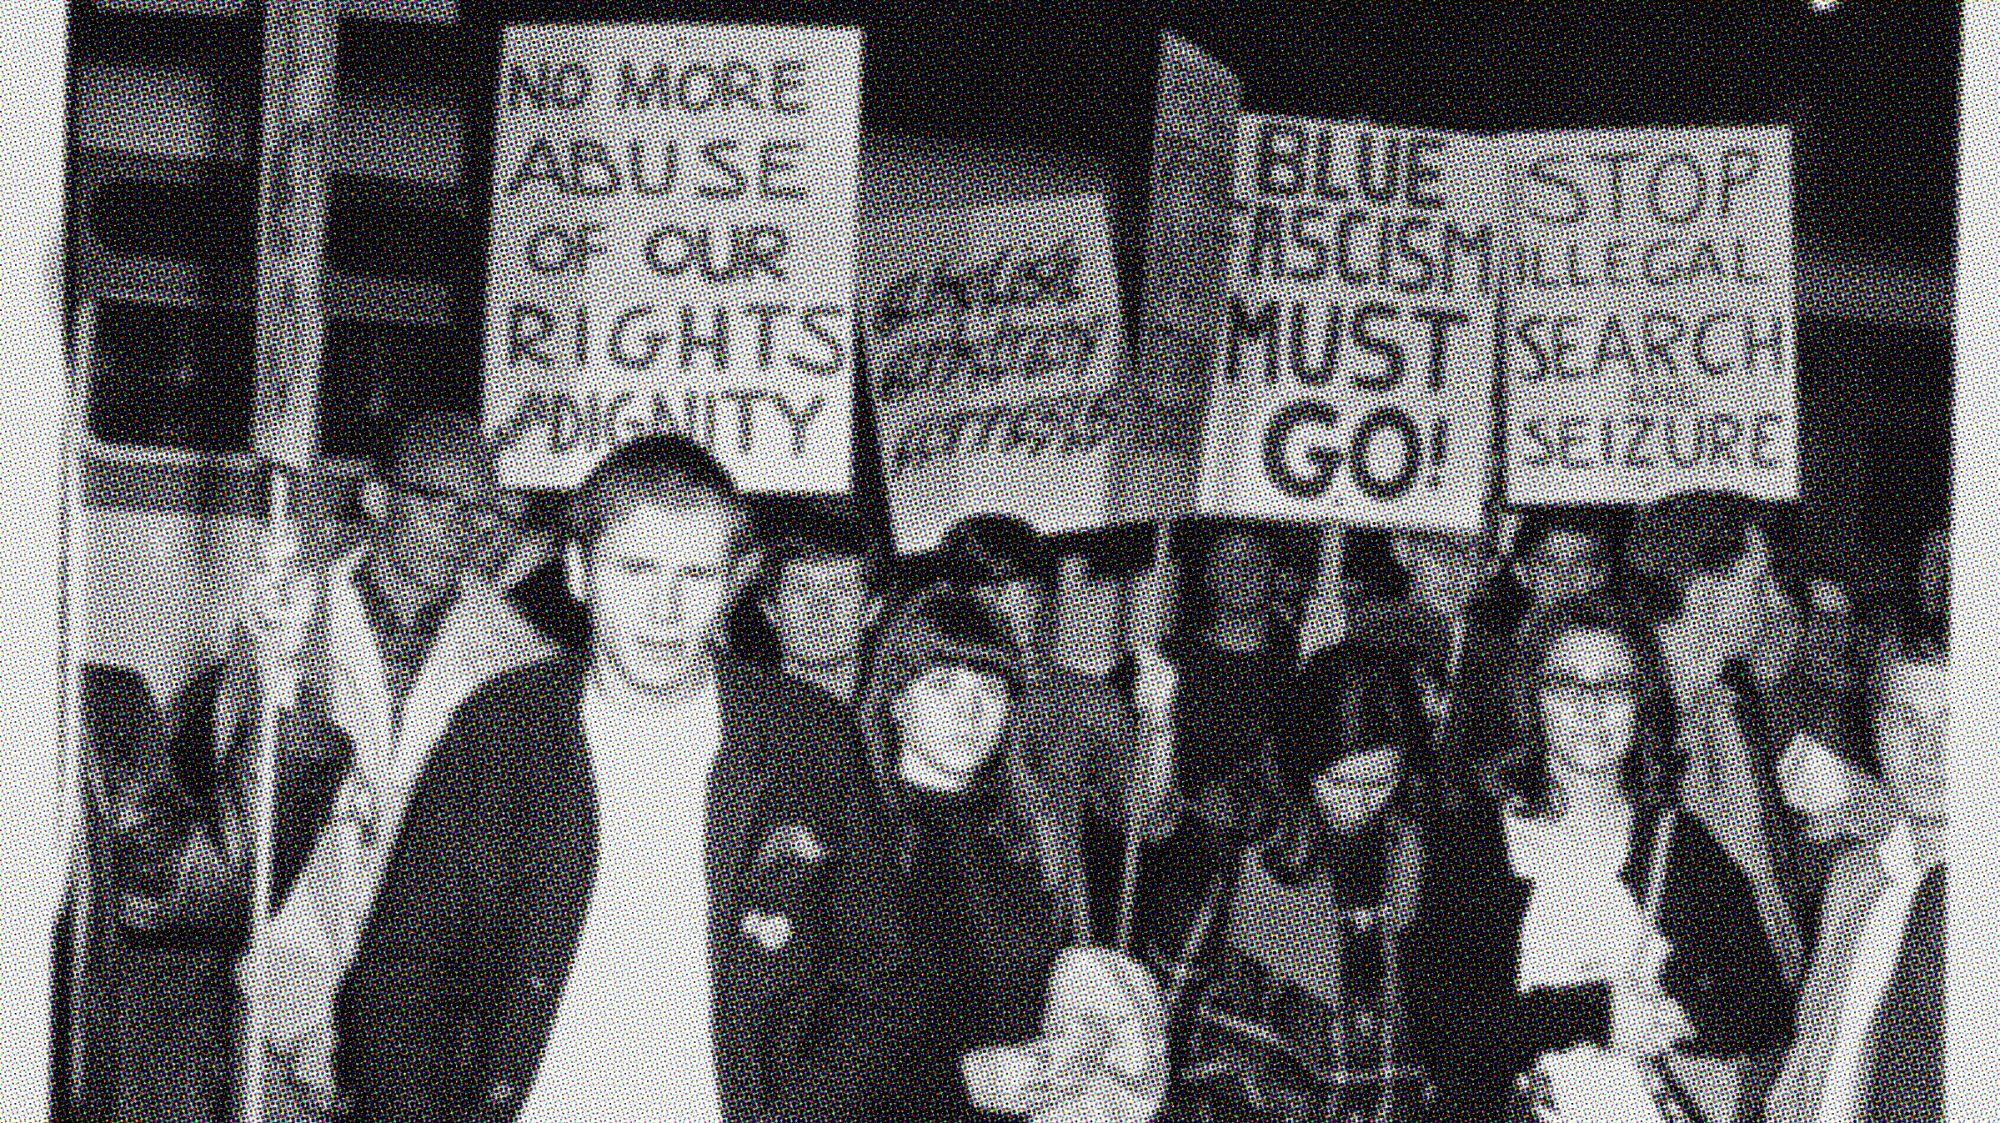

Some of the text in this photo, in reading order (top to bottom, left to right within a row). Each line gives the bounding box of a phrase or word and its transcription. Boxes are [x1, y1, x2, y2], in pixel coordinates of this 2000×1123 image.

[507, 59, 809, 115] NO MORE
[505, 136, 808, 200] ABUSE
[1257, 121, 1449, 210] BLUE
[1525, 147, 1762, 226] STOP
[525, 222, 789, 282] OF OUR
[1514, 236, 1766, 290] ILLEGAL
[507, 303, 846, 376] RIGHTS
[1225, 294, 1471, 394] MUST
[1514, 310, 1784, 382] SEARCH
[550, 388, 825, 457] DIGNITY
[1262, 398, 1450, 502] GO!
[1521, 410, 1784, 471] SEIZURE
